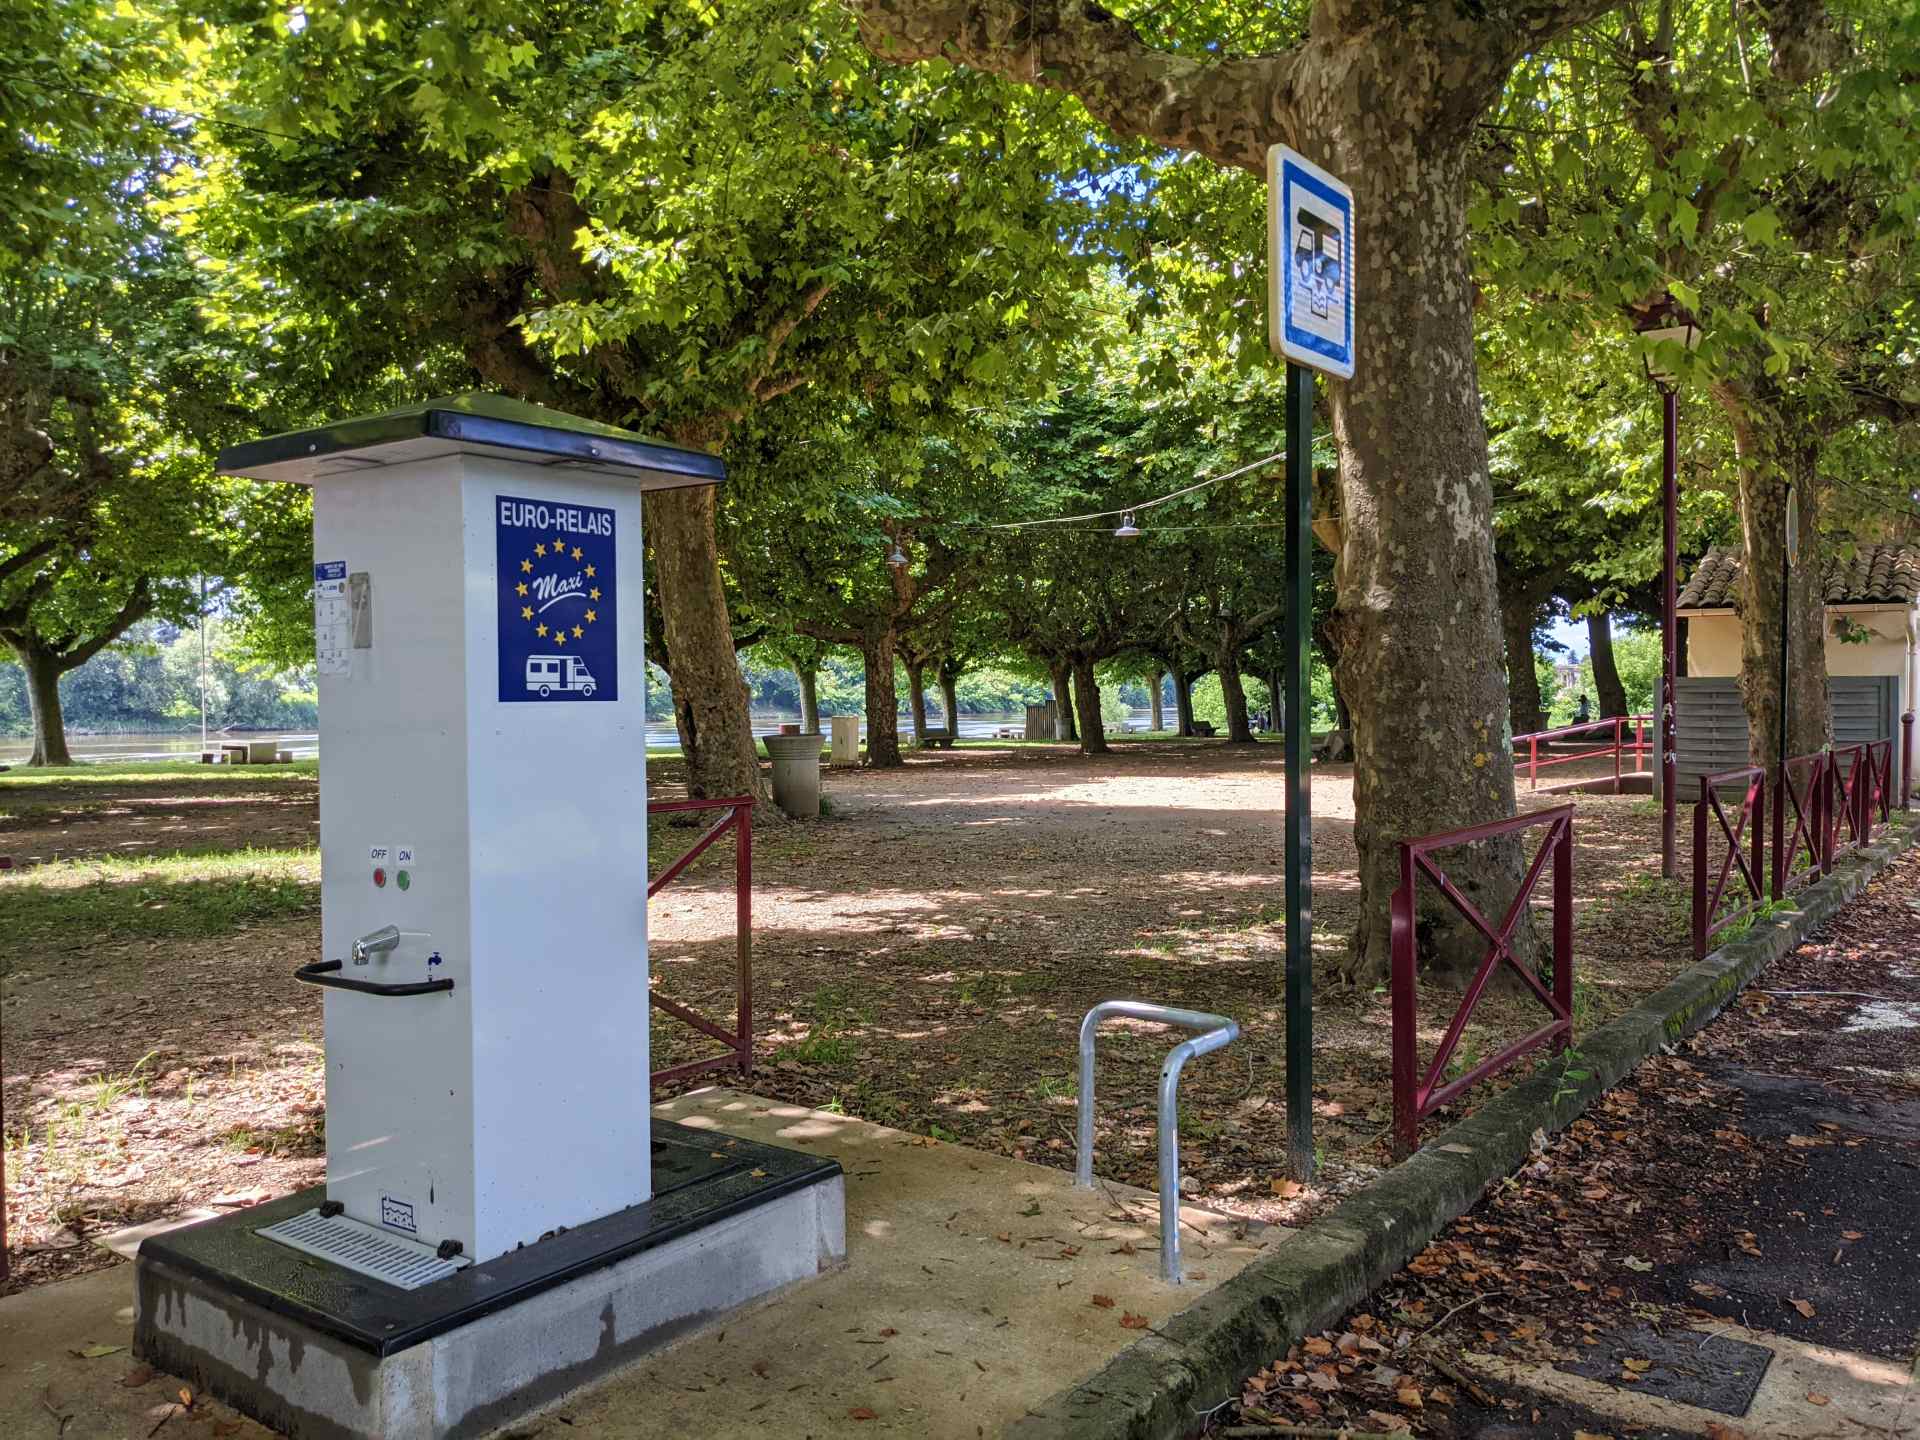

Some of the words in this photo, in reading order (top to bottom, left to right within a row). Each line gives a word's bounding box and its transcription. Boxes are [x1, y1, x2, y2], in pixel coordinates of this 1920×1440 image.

[501, 501, 612, 536] EURO-RELAIS
[532, 571, 583, 600] Maxi
[371, 848, 387, 859] OFF
[399, 850, 412, 861] ON
